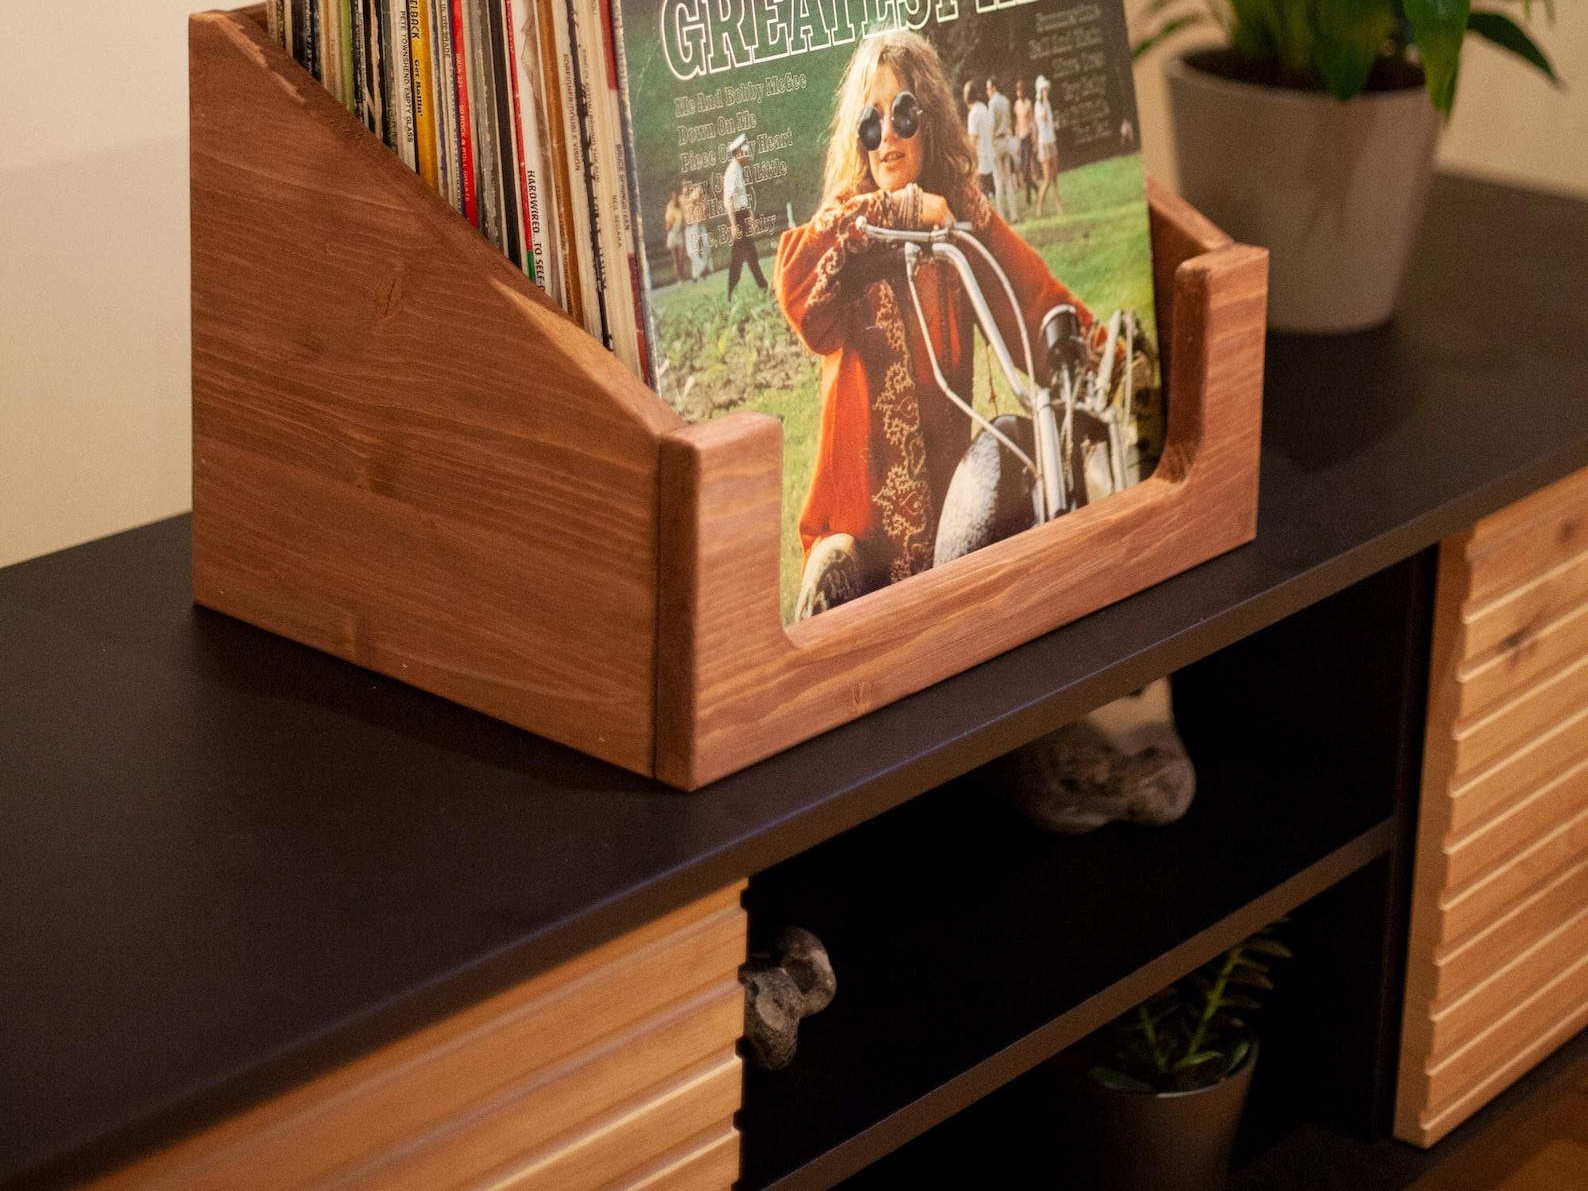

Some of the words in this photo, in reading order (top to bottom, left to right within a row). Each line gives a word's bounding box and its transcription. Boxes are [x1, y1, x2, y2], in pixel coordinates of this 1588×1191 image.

[415, 80, 424, 118] Rollin'
[674, 95, 696, 119] Me
[697, 88, 724, 113] And
[724, 81, 764, 106] Bobby
[765, 71, 807, 97] McGee
[406, 115, 414, 143] GLASS
[677, 122, 717, 146] Down
[717, 115, 736, 137] On
[736, 110, 757, 132] Me
[573, 142, 581, 172] VISION
[616, 143, 625, 171] BRUCE
[679, 150, 717, 173] Piece
[757, 127, 794, 154] Heart
[683, 179, 709, 202] Try
[743, 165, 754, 186] A
[753, 157, 788, 184] Little
[707, 186, 758, 220] Hader)
[614, 214, 624, 248] SEDAKA
[743, 213, 777, 238] Baby
